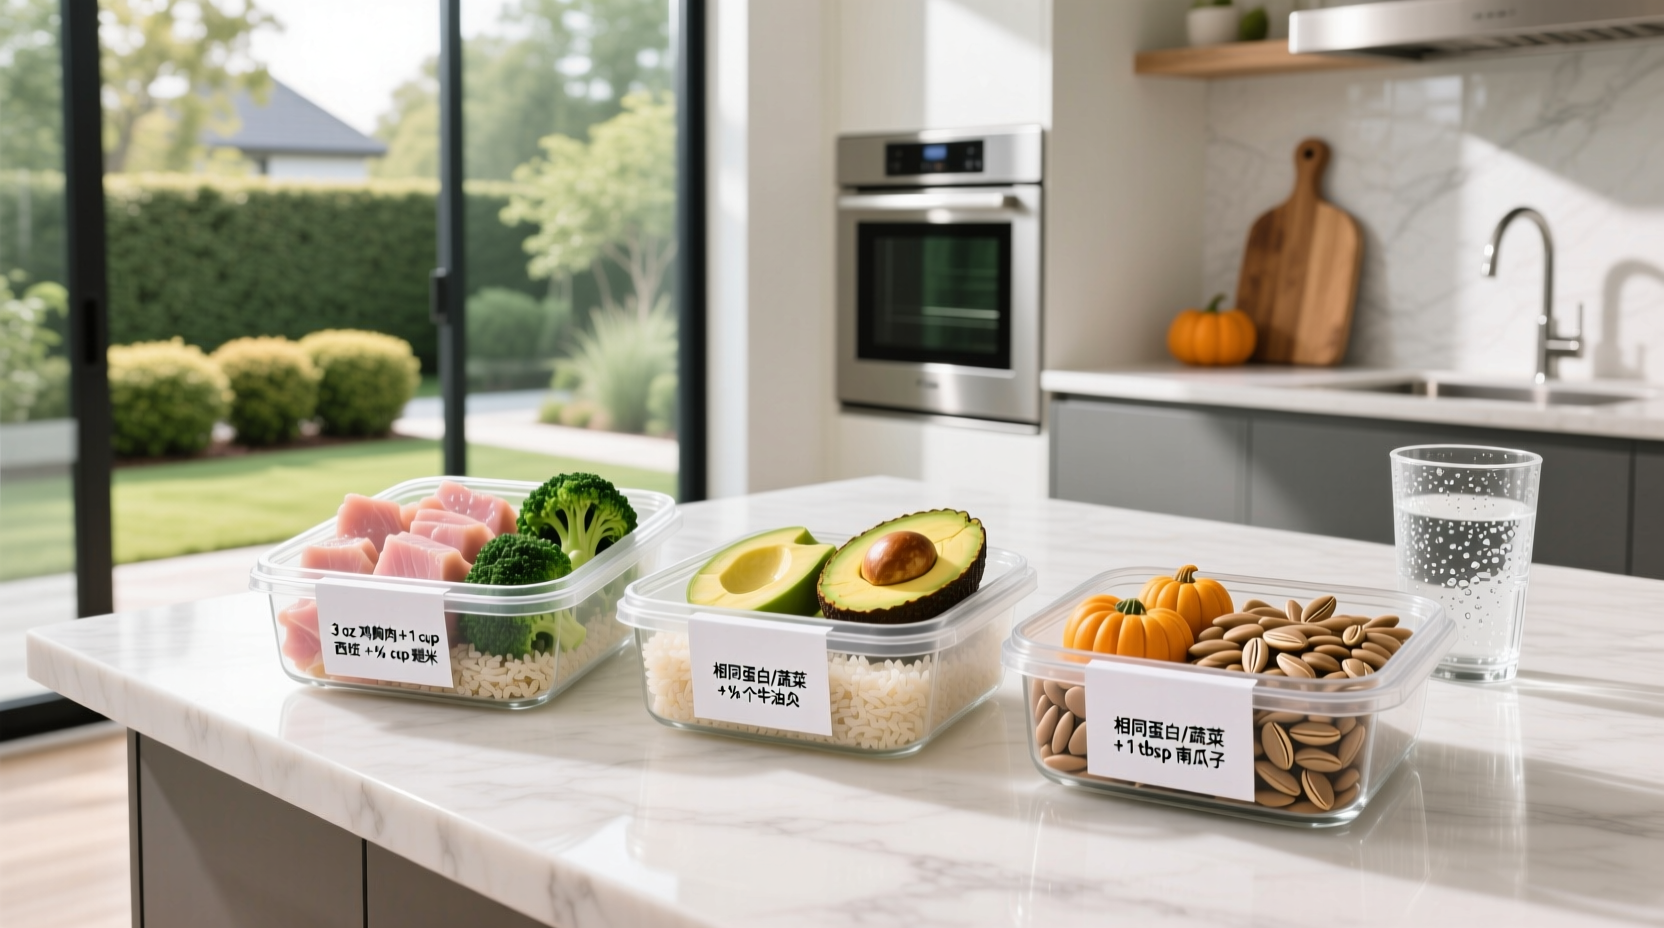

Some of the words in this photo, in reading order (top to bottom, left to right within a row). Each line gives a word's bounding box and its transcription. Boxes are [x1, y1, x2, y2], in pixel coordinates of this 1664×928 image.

[331, 622, 339, 636] 3
[342, 627, 357, 638] oz
[418, 633, 440, 647] cup
[390, 650, 410, 663] cup
[713, 661, 808, 689] 相同蛋白/蔬菜
[1113, 715, 1226, 749] 相同蛋白/蔬菜
[1138, 739, 1172, 764] tbsp
[1175, 745, 1226, 769] 南瓜子
